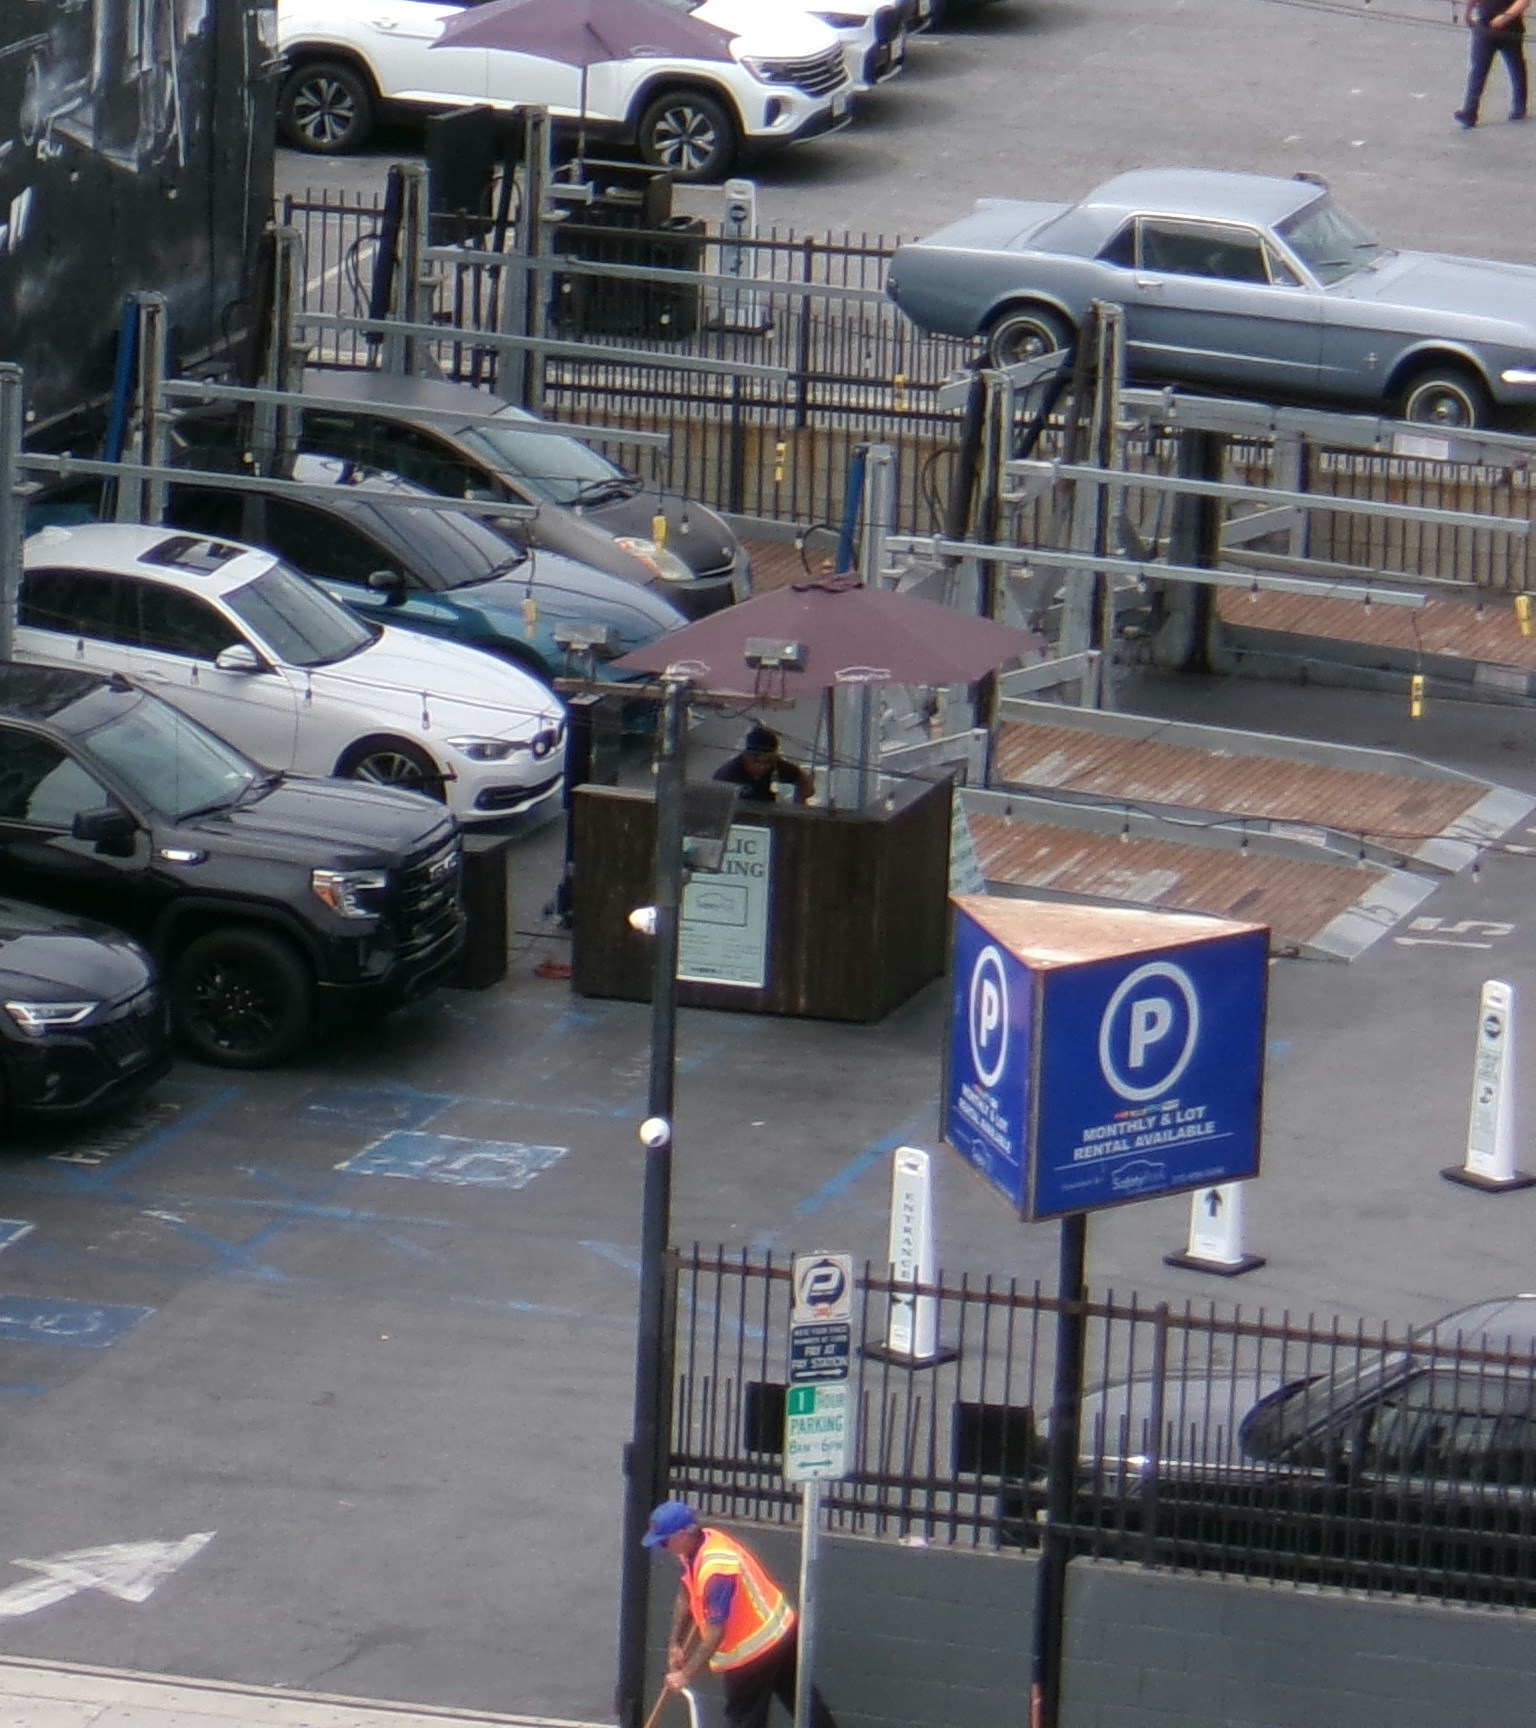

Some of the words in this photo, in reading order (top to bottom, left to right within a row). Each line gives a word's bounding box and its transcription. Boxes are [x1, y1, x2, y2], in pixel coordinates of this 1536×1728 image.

[981, 977, 1000, 1049] P
[1128, 997, 1173, 1069] P
[1072, 1140, 1132, 1162] RENTAL
[1134, 1121, 1217, 1148] AVAILABLE
[1082, 1116, 1157, 1143] MONTHLY
[1160, 1112, 1172, 1125] &
[1177, 1105, 1208, 1123] LOT
[900, 1192, 915, 1281] ENTRANCE
[790, 1415, 843, 1434] PARKING
